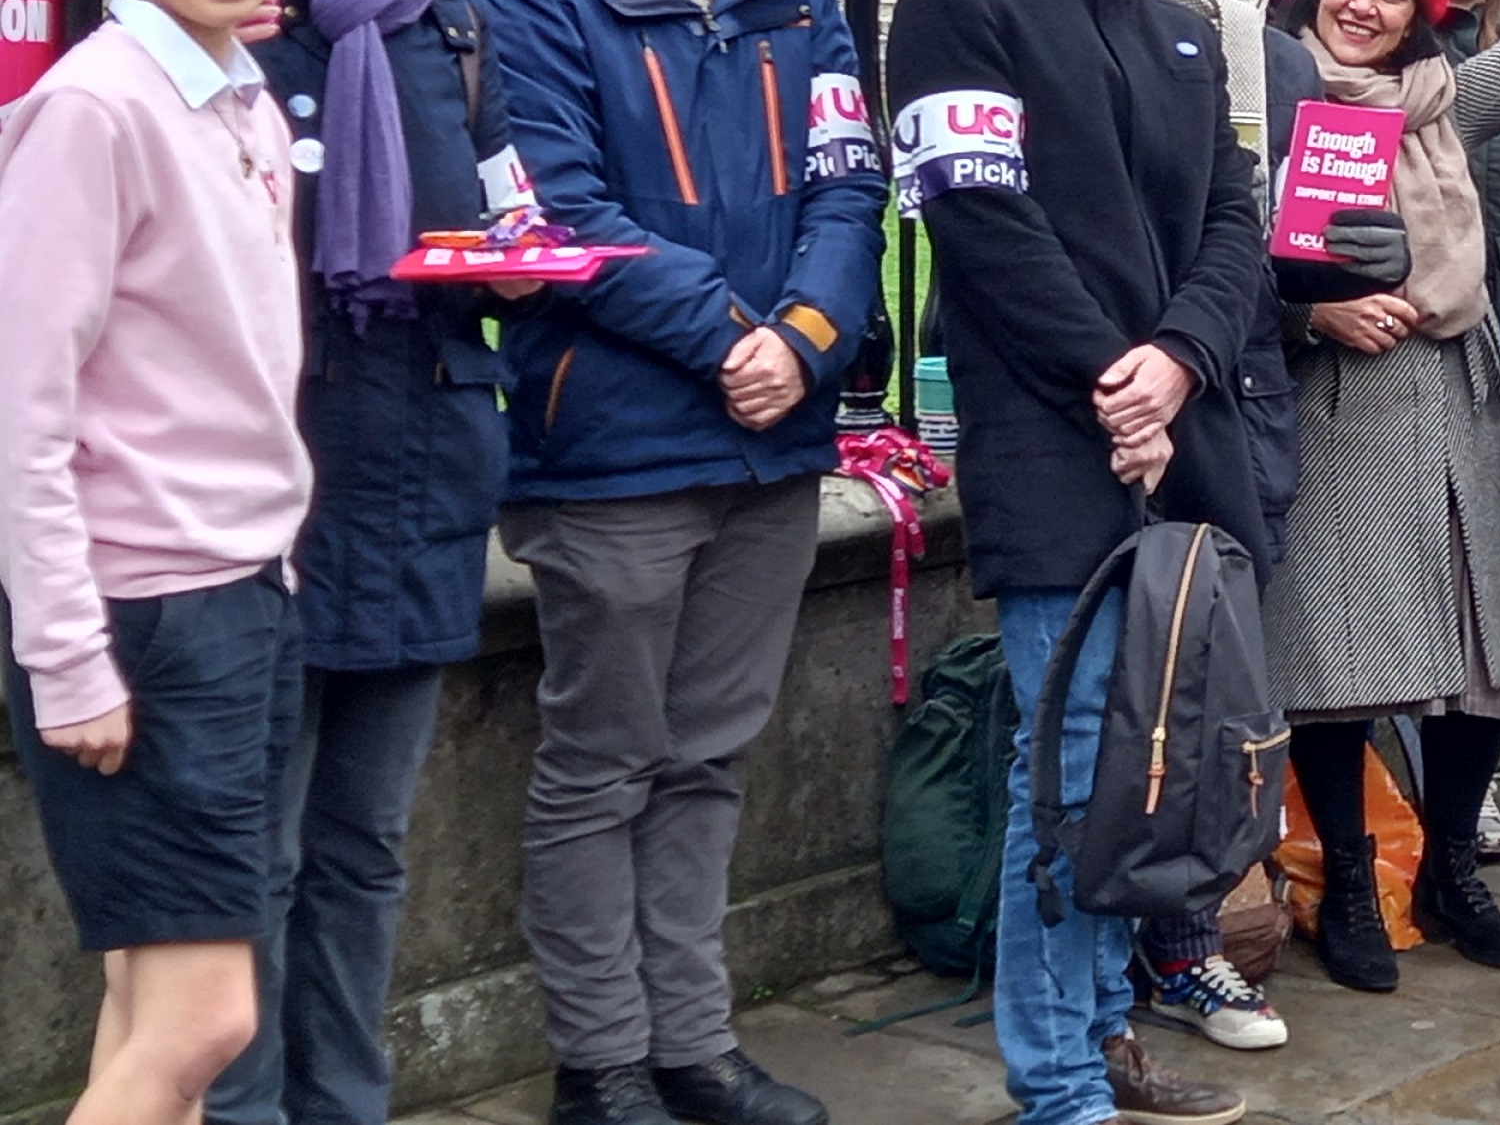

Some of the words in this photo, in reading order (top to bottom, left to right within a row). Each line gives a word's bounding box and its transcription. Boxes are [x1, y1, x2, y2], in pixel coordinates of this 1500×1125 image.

[948, 104, 1026, 143] UC
[1307, 125, 1376, 159] Enough
[1301, 150, 1321, 173] is
[1321, 152, 1388, 186] Enough
[1289, 231, 1324, 248] UCU
